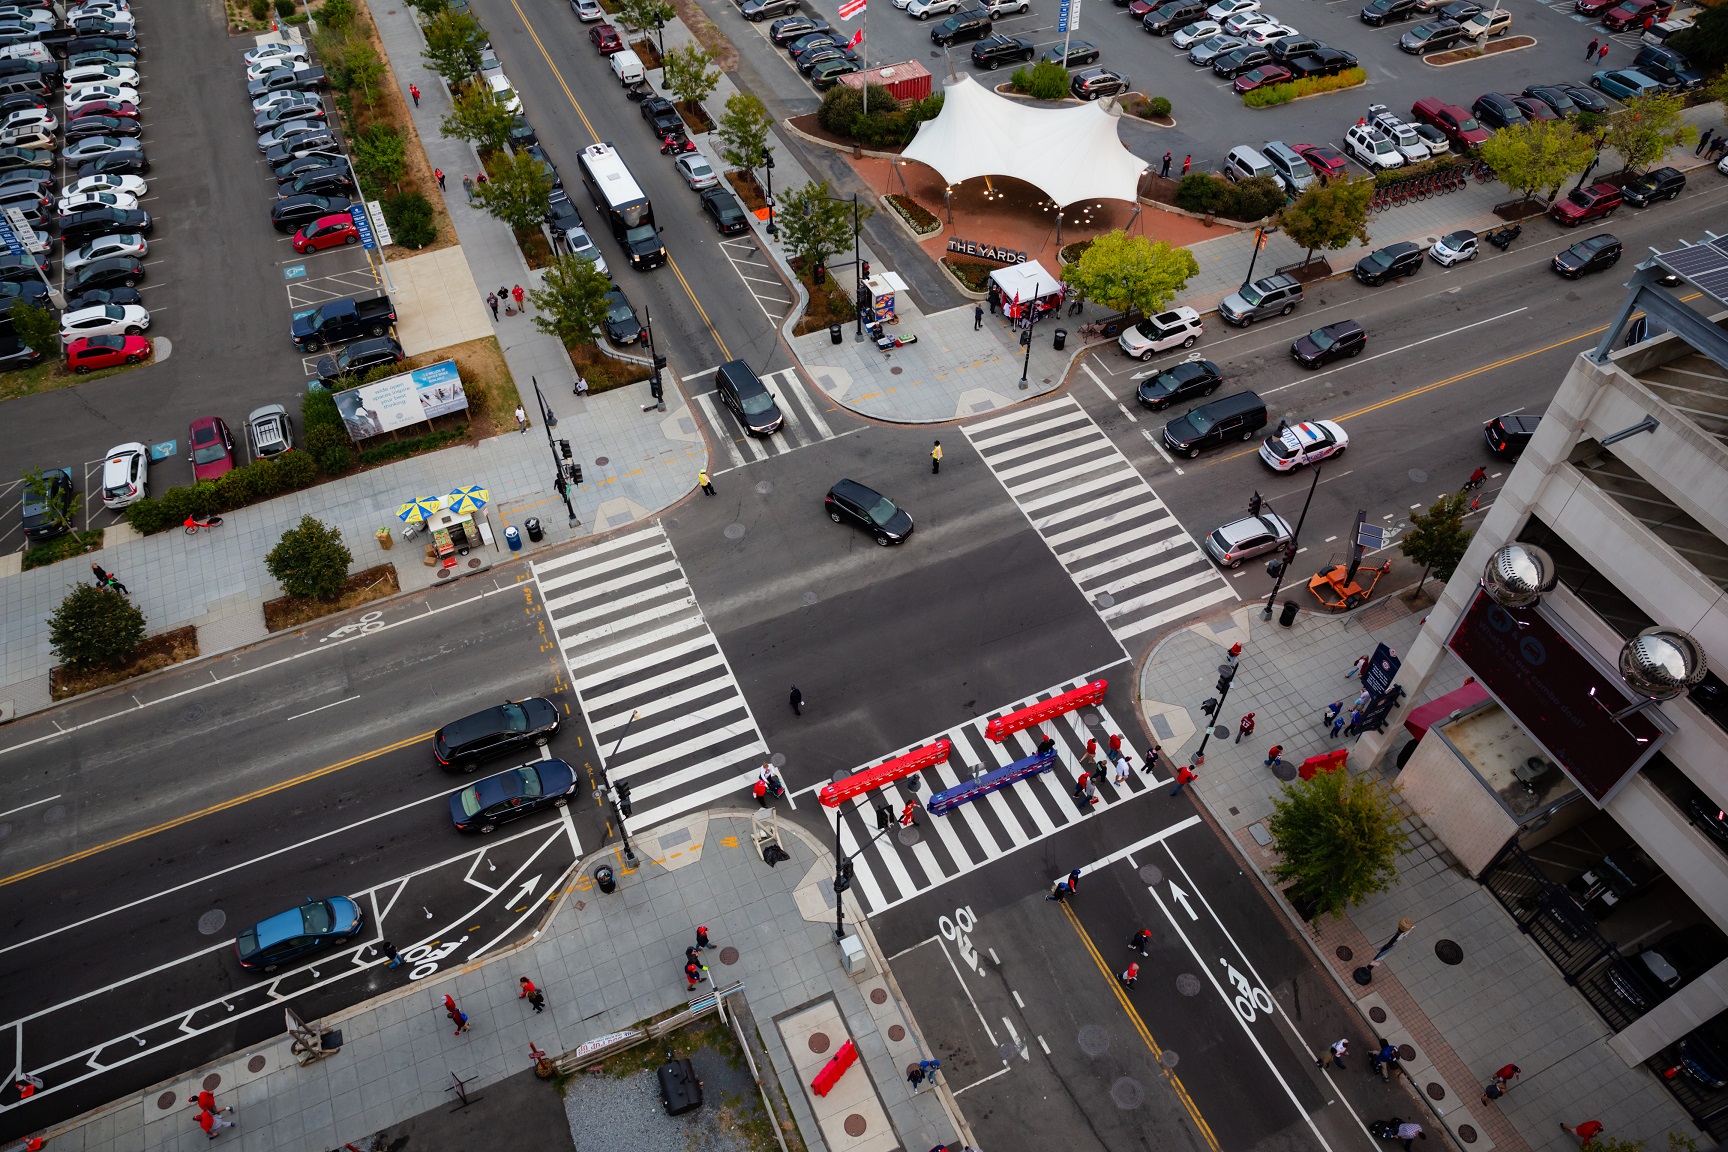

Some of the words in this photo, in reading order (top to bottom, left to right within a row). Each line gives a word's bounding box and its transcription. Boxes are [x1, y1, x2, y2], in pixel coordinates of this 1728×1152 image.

[948, 240, 976, 254] THE
[980, 246, 1026, 264] YARDS
[389, 382, 404, 391] open
[372, 392, 392, 402] spaces
[392, 387, 410, 397] inspire
[380, 397, 394, 405] your
[1516, 660, 1531, 675] our
[1531, 675, 1560, 705] combo
[1560, 705, 1586, 729] deal?
